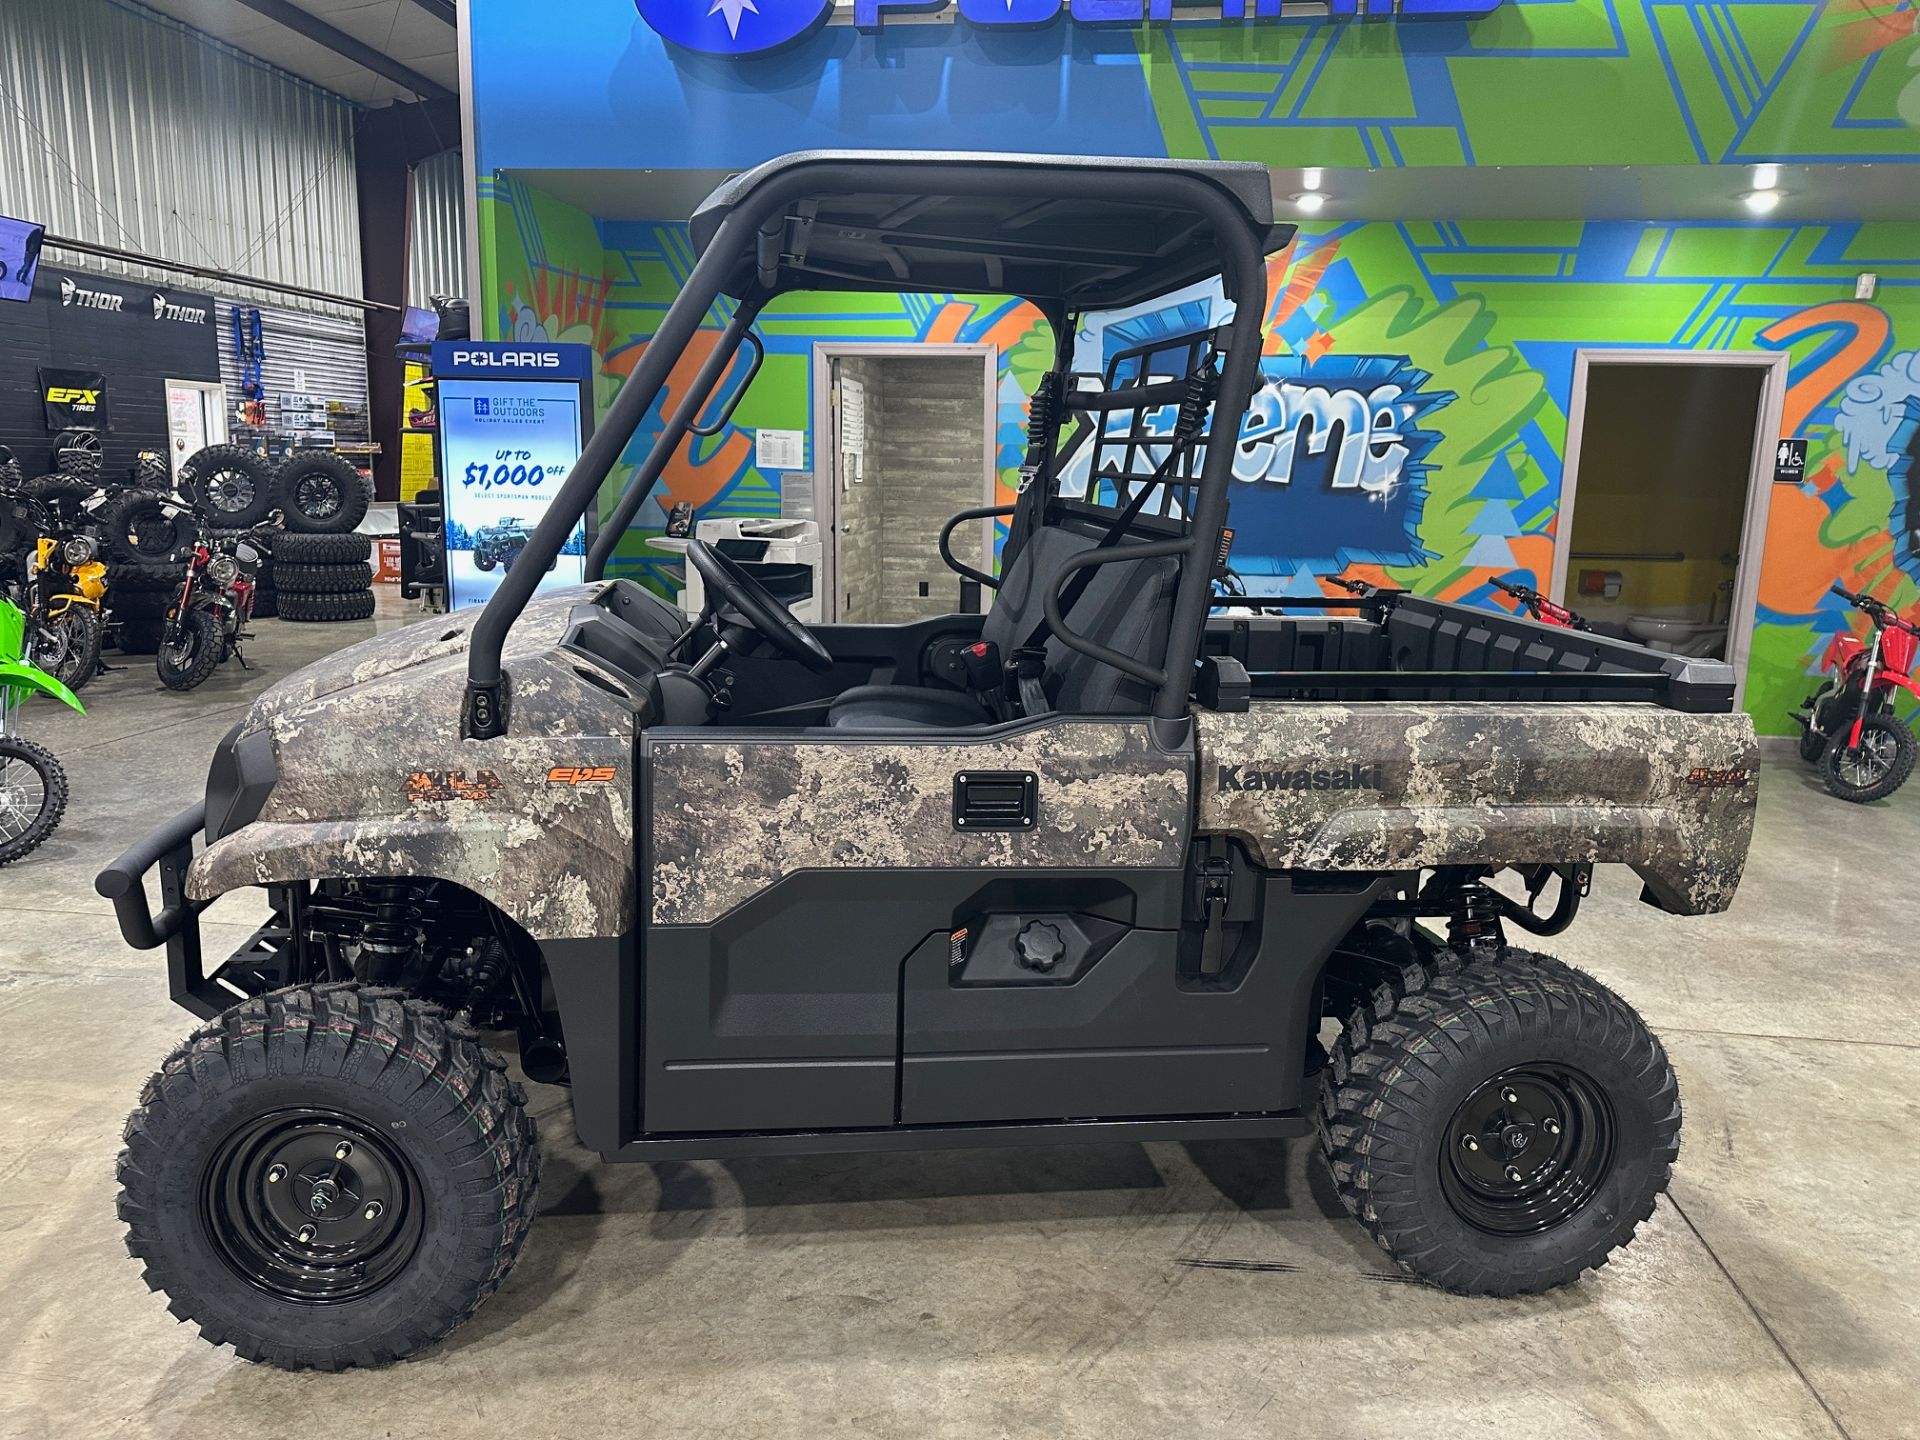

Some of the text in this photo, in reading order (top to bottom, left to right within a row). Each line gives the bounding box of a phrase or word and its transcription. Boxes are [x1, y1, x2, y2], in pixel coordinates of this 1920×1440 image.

[76, 289, 123, 312] THOR
[166, 304, 206, 324] THOR
[453, 351, 560, 367] POLARIS
[47, 387, 101, 404] EFX
[493, 397, 536, 407] GIFT THE
[71, 404, 97, 412] TIRES
[493, 407, 545, 417] OUTDOORS
[495, 449, 531, 461] UP TO
[462, 461, 544, 490] $1,000
[547, 767, 618, 785] EPS
[1218, 763, 1383, 791] Kawasaki
